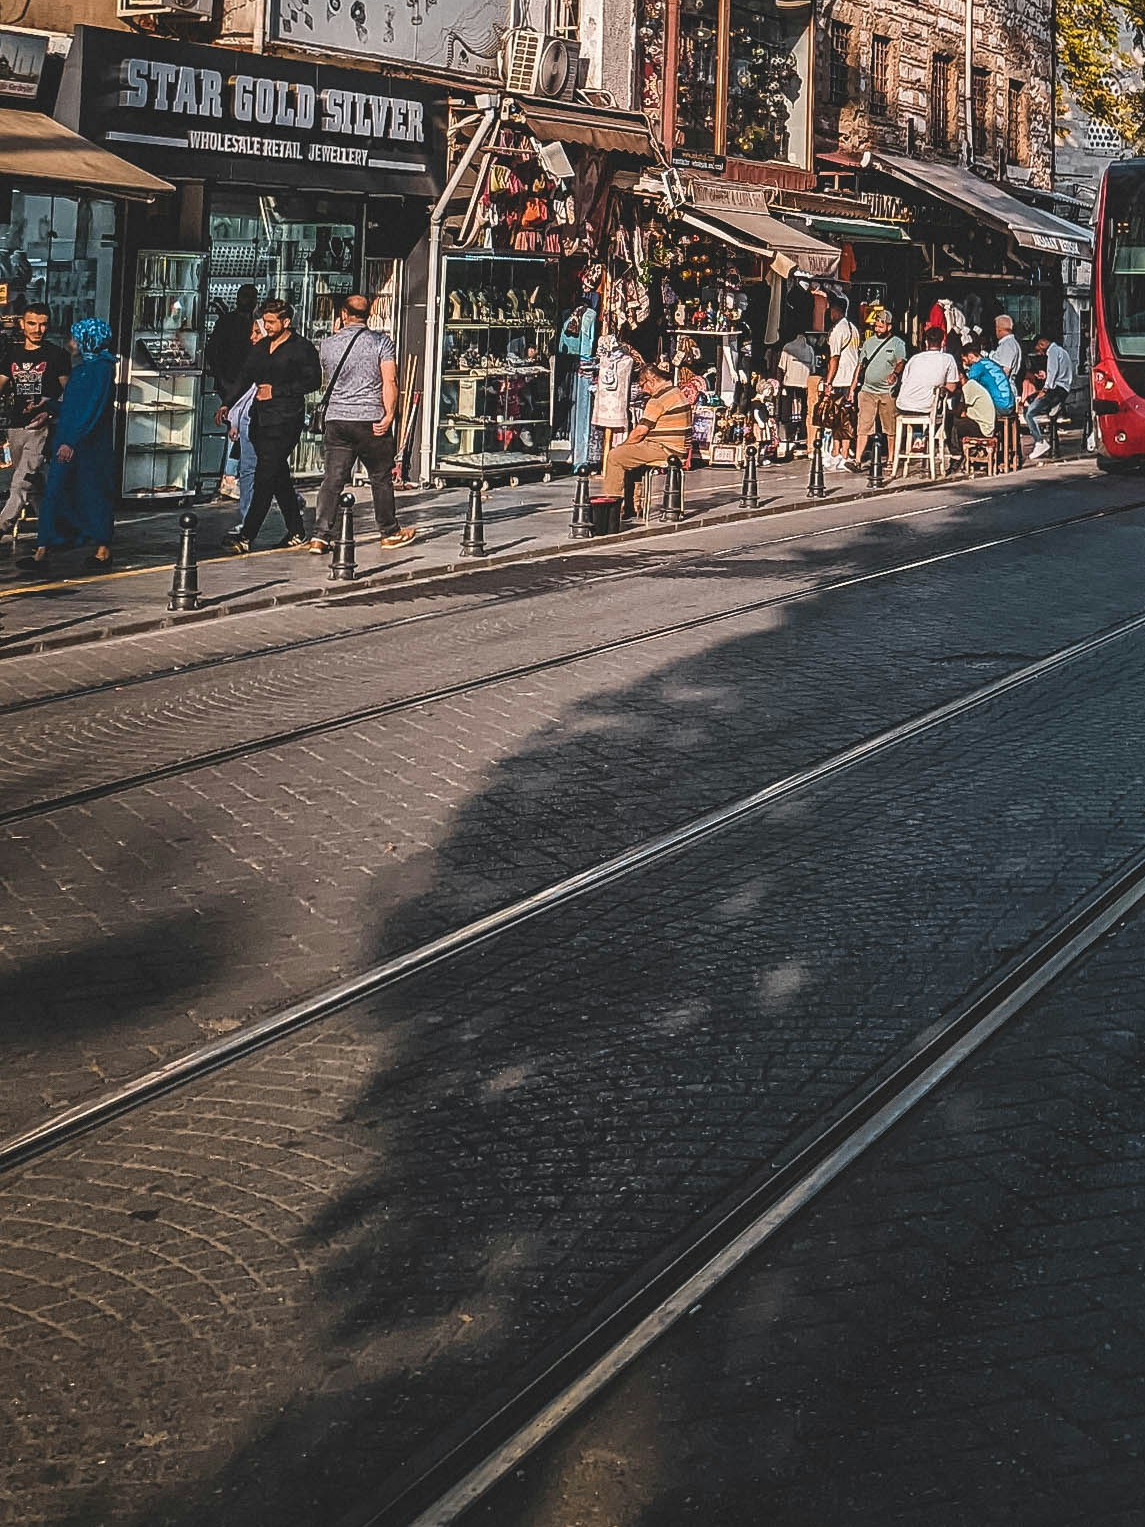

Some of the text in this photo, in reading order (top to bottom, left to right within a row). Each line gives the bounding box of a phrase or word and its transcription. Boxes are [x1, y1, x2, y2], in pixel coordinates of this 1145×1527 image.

[120, 59, 424, 142] STAR GOLD SILVER
[188, 130, 369, 166] WHOLESALE RETAIL JEWELLERY
